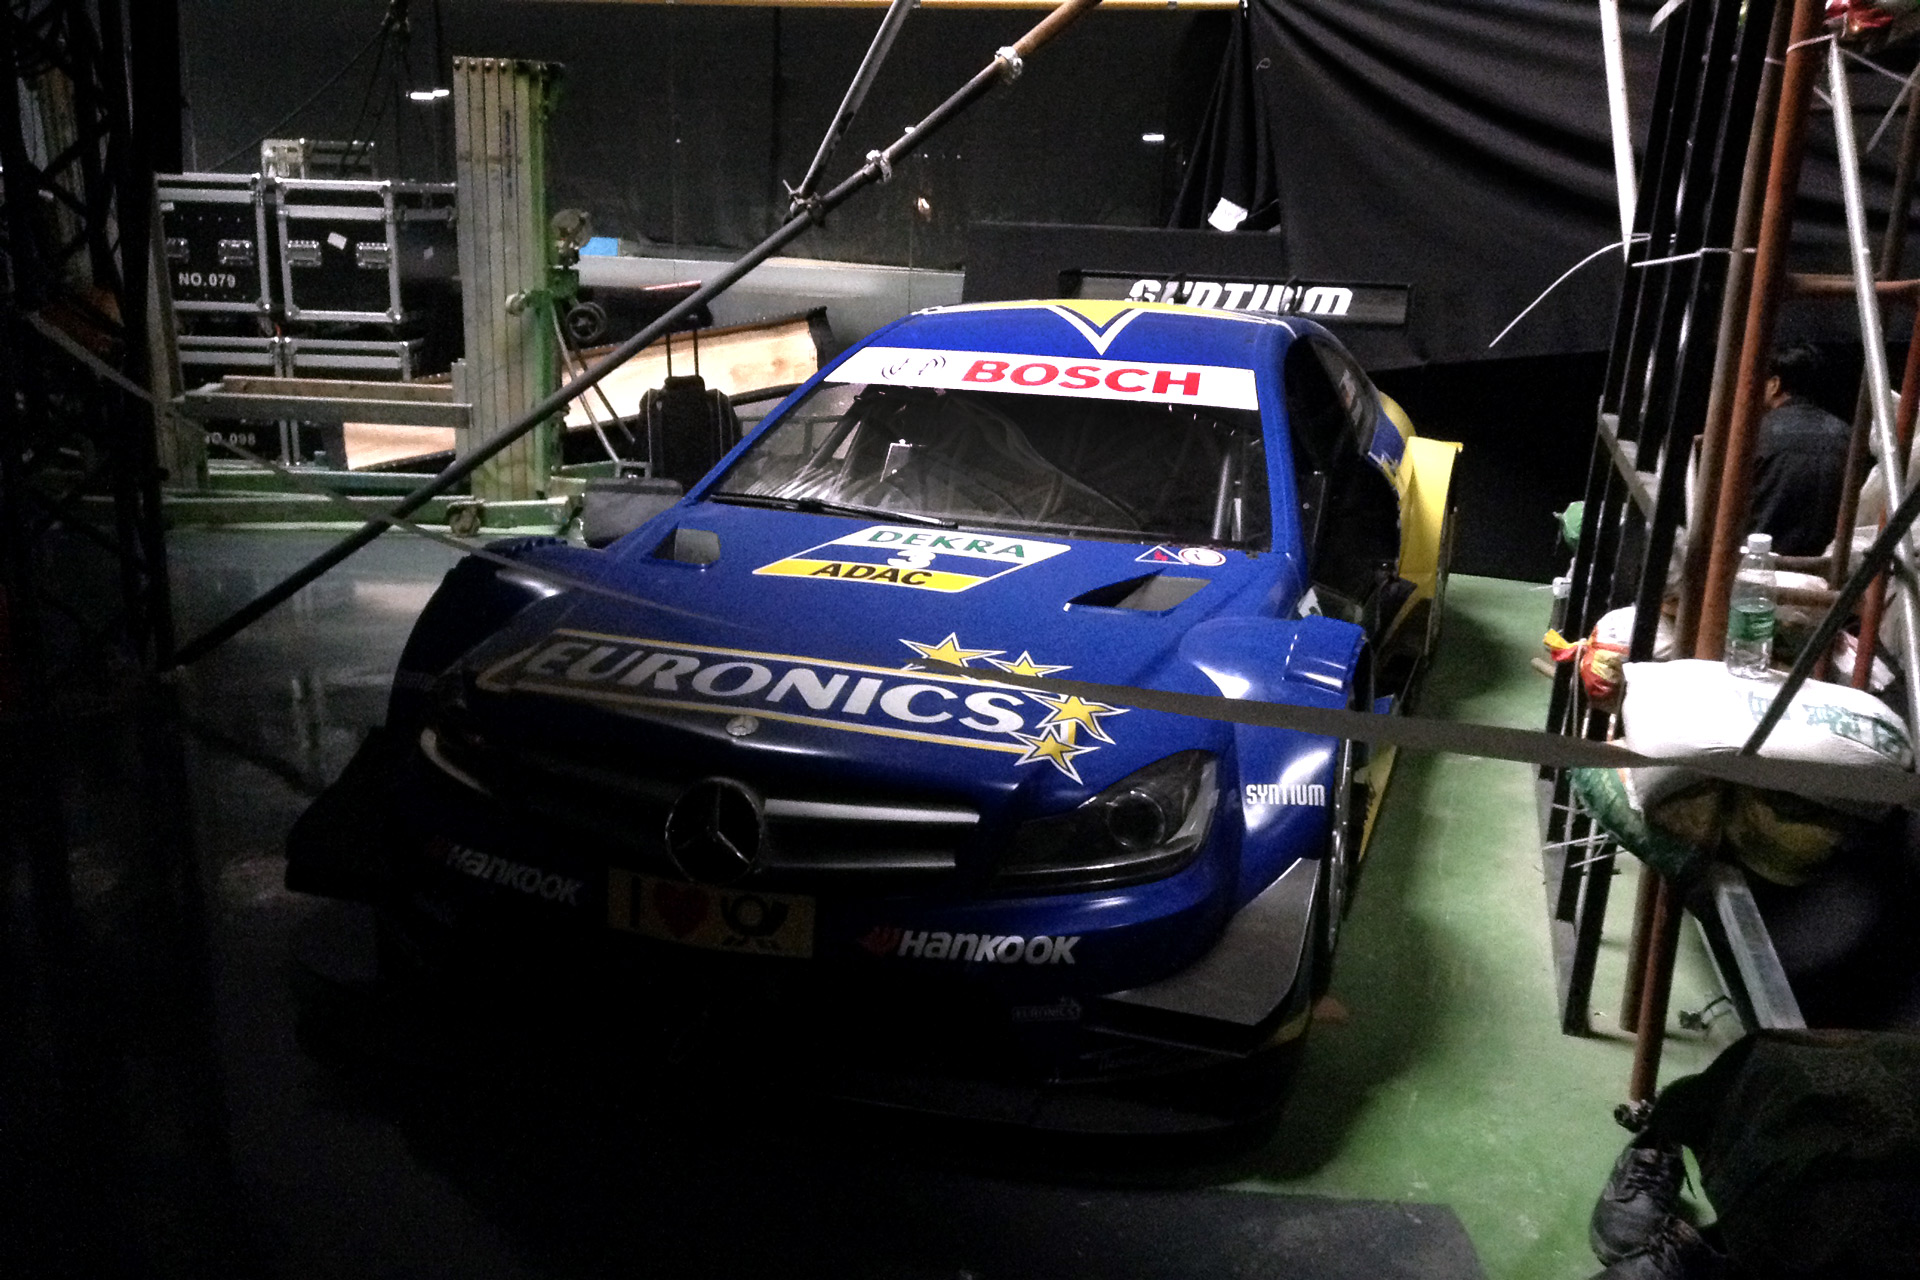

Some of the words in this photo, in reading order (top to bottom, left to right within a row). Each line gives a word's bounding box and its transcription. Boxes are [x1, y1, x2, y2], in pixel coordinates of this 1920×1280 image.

[178, 272, 236, 288] NO.079
[961, 359, 1201, 396] BOSCH
[867, 530, 1026, 558] DEKRA
[887, 549, 936, 569] 3
[808, 562, 933, 586] ADAC
[523, 640, 1025, 735] EURONICS
[1245, 783, 1325, 807] SYNTIUM
